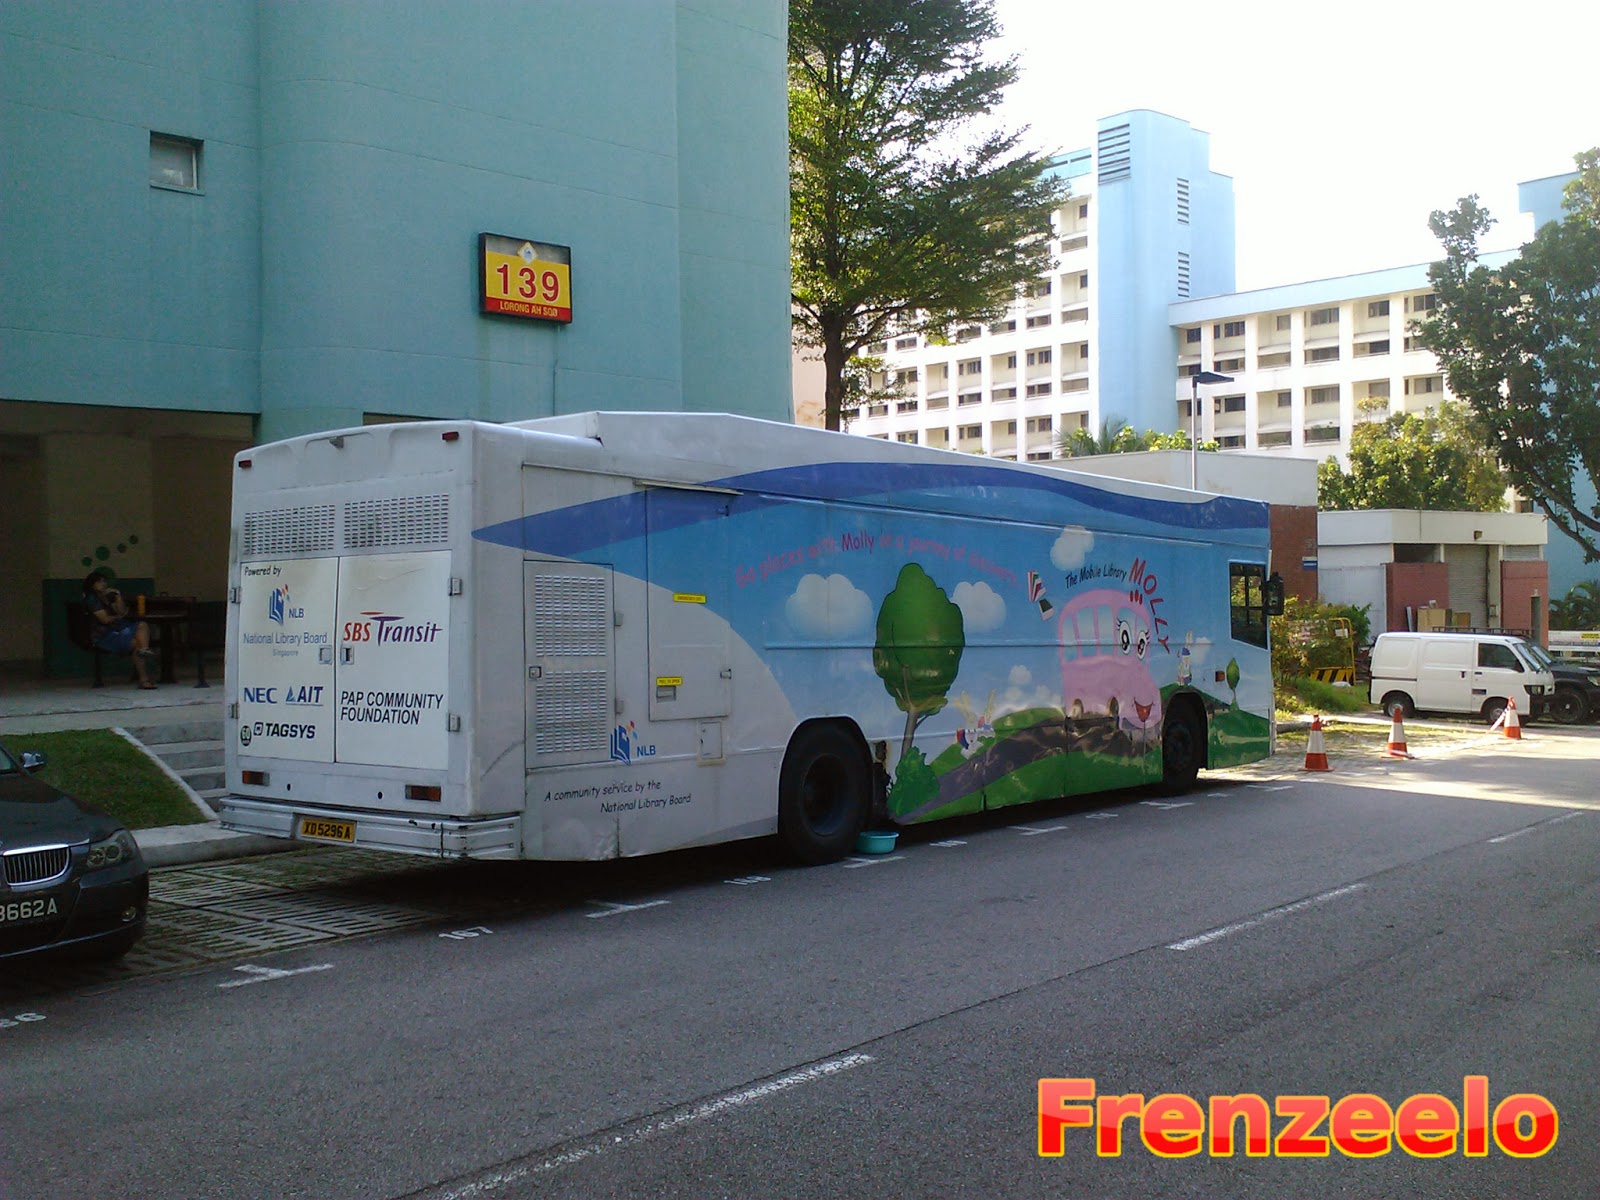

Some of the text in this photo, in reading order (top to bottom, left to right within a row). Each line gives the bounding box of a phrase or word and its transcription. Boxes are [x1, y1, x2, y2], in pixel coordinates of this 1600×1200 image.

[496, 263, 560, 303] 139
[500, 300, 530, 313] LORONG
[531, 305, 542, 314] AH
[735, 565, 757, 589] Go
[759, 552, 805, 583] places
[807, 535, 838, 559] with
[841, 529, 875, 554] Molly
[907, 535, 950, 561] journey
[244, 565, 282, 577] Powered by
[288, 608, 304, 619] NLB
[1065, 557, 1171, 655] The Mobile Library MOLLY
[243, 632, 328, 647] National Library Board
[343, 615, 443, 647] SBS Transit
[272, 649, 299, 658] Singapore
[243, 687, 278, 704] NEC
[299, 686, 324, 703] AIT
[340, 691, 444, 710] PAP COMMUNITY
[340, 707, 421, 725] FOUNDATION
[265, 722, 316, 739] TAGSYS
[636, 745, 656, 757] NLB
[544, 779, 662, 802] A community service by the
[600, 793, 692, 813] National Library Board
